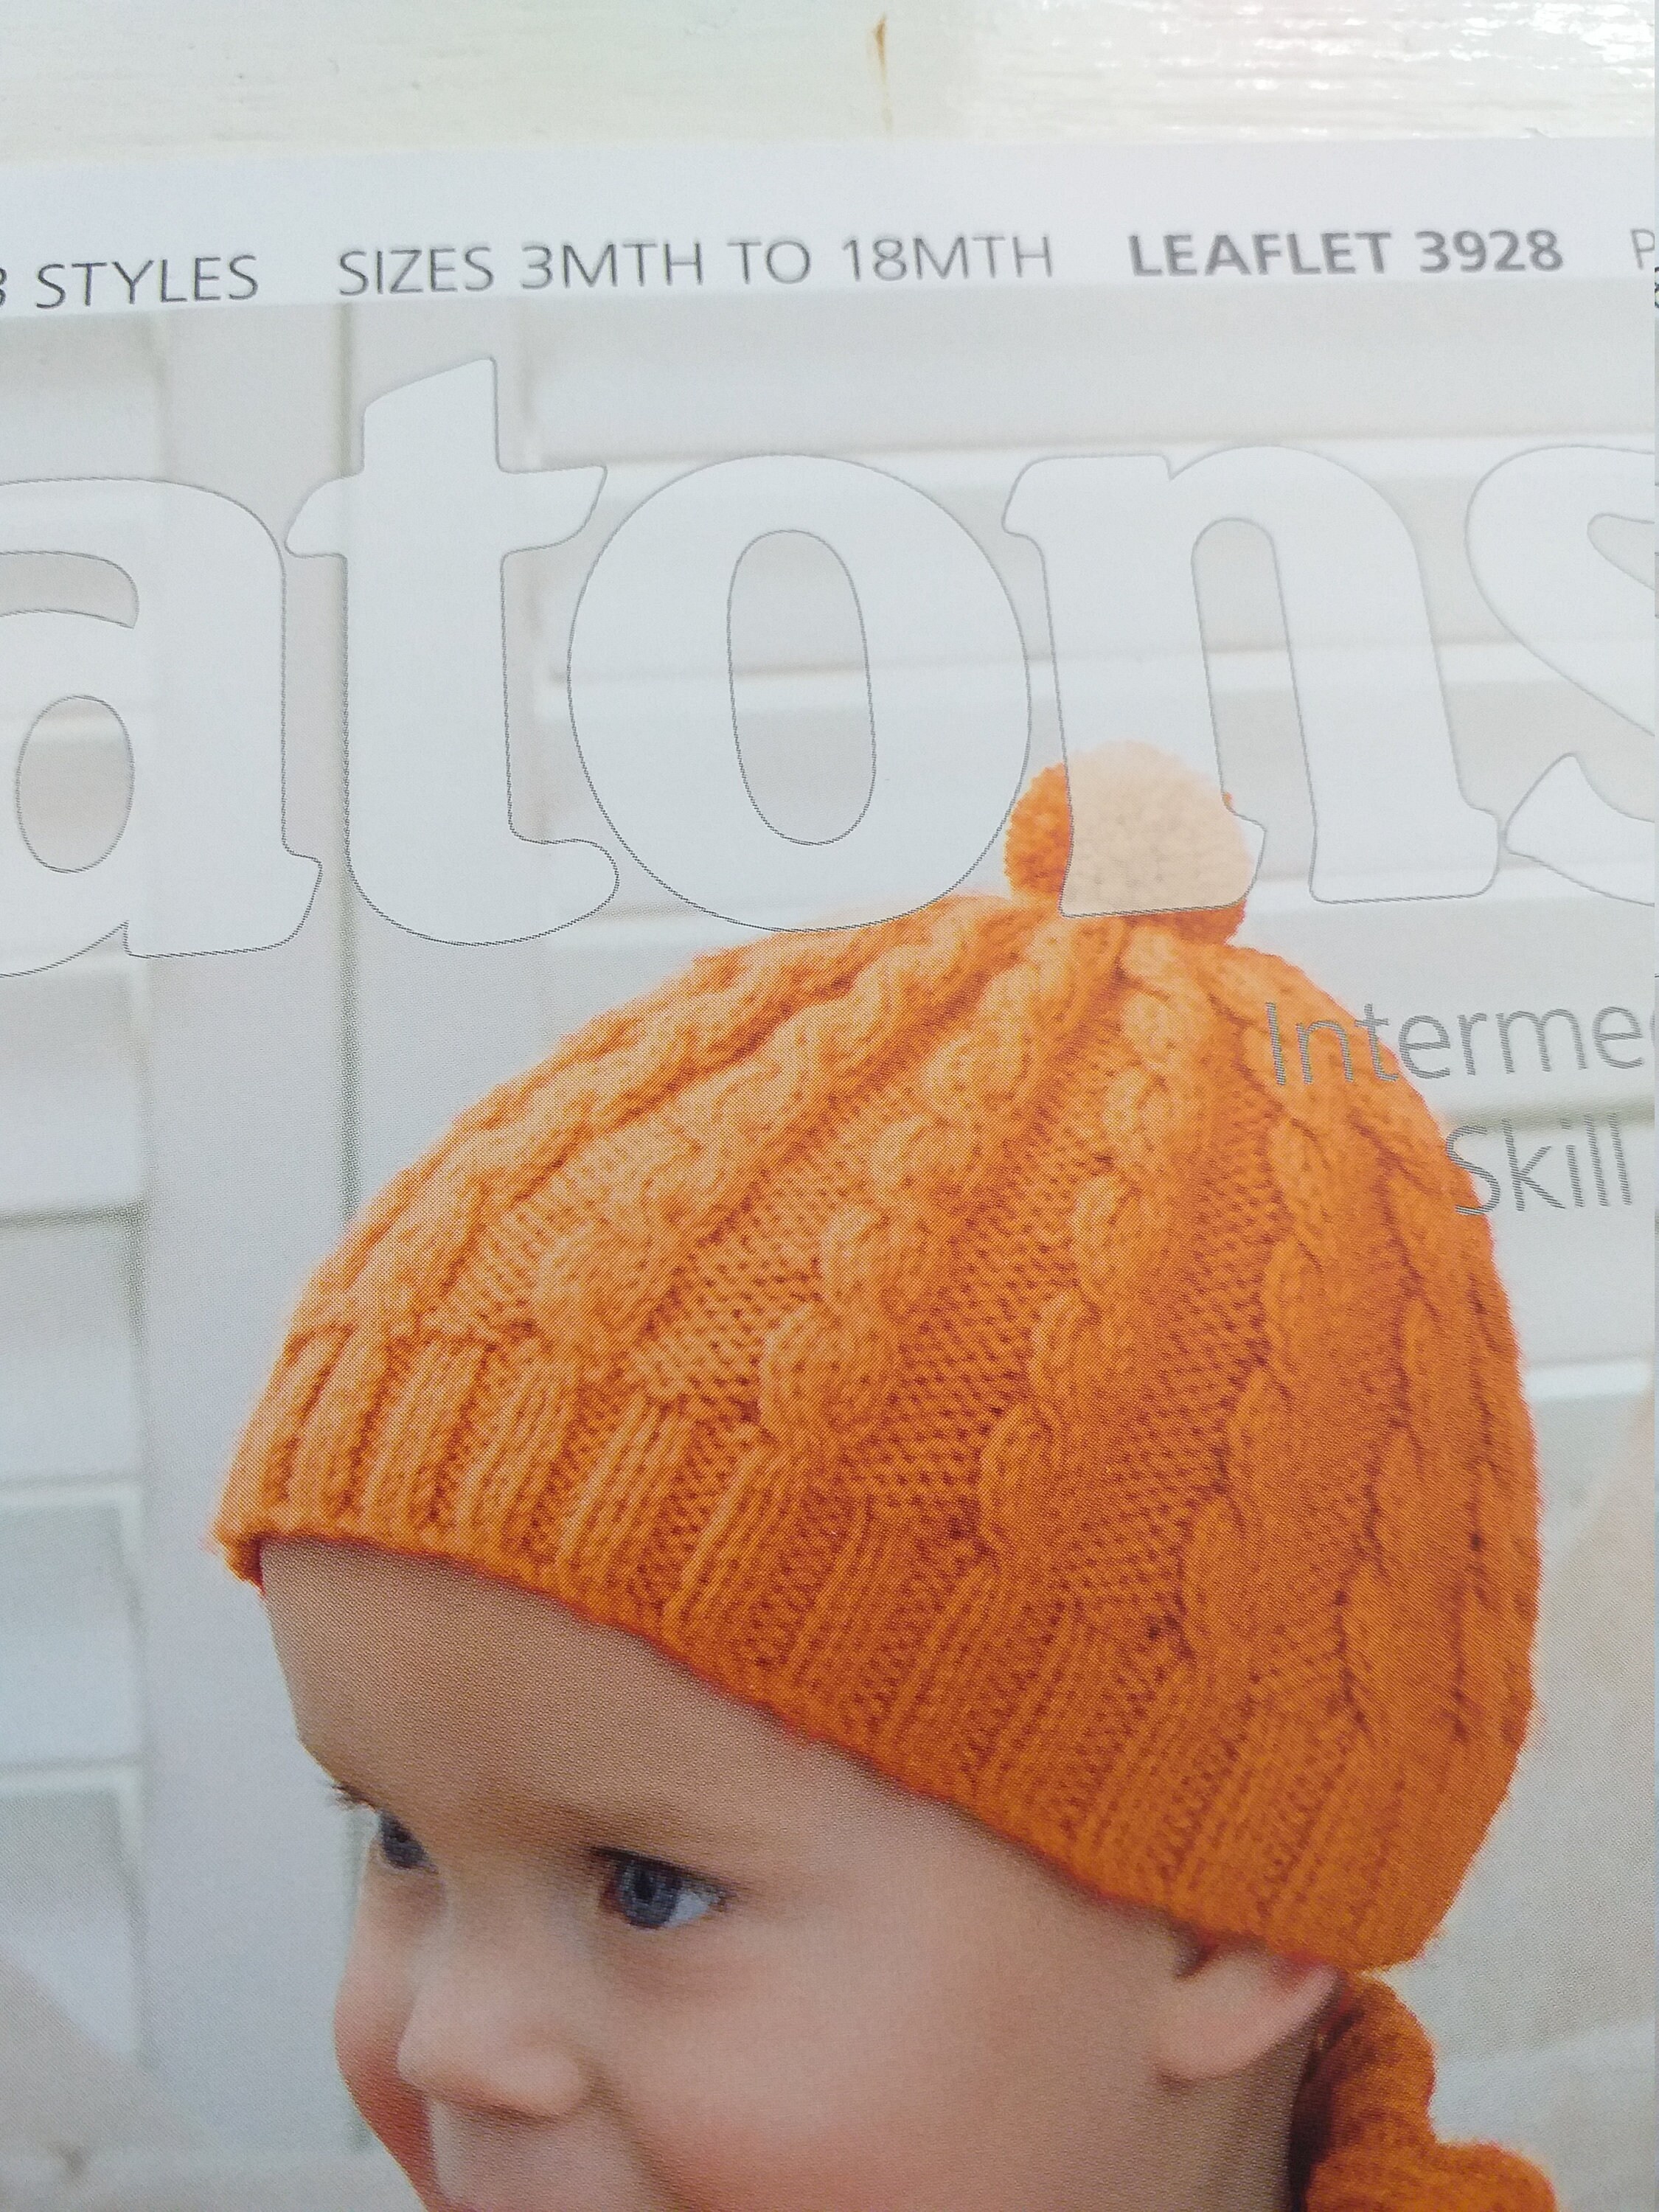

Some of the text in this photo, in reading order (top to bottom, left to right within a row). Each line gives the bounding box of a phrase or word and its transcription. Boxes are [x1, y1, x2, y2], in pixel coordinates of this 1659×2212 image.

[35, 255, 260, 310] STYLES
[338, 242, 495, 296] SIZES
[518, 240, 704, 291] 3MTH
[727, 237, 813, 286] TO
[841, 234, 1055, 283] 18MTH
[1127, 228, 1565, 278] LEAFLET 3928
[1265, 1000, 1655, 1085] Interme
[1445, 1112, 1632, 1216] Skill
